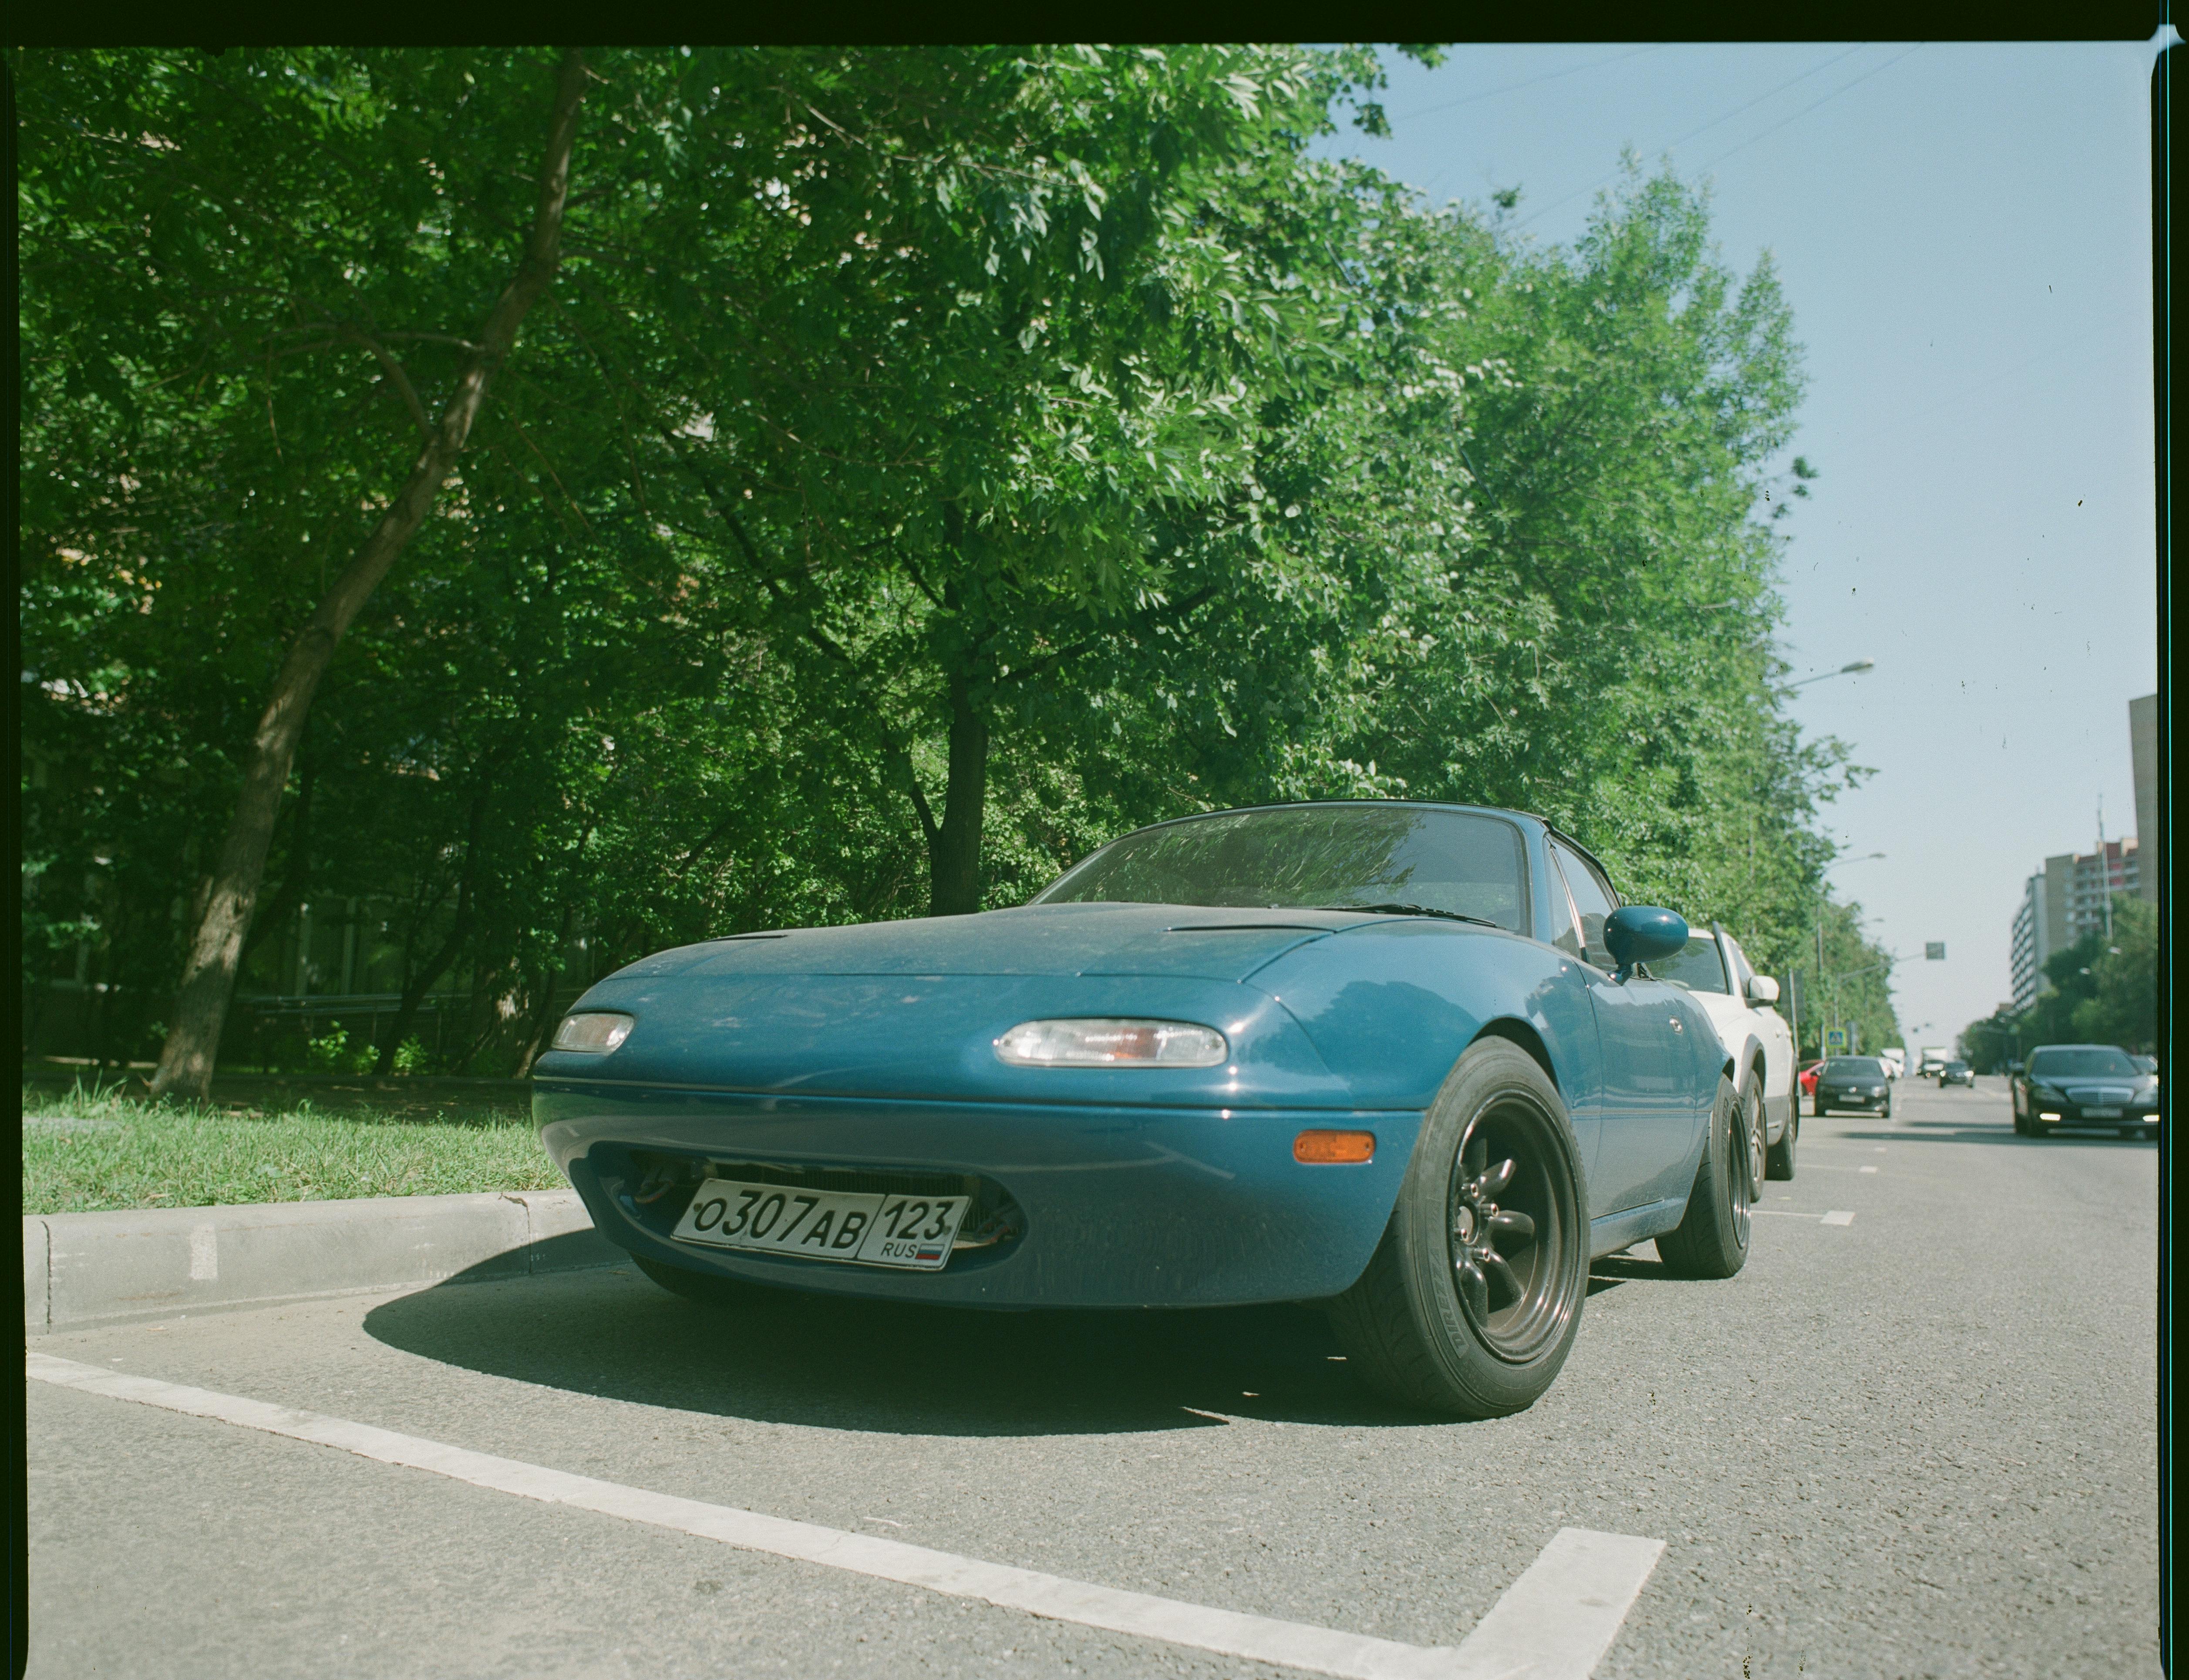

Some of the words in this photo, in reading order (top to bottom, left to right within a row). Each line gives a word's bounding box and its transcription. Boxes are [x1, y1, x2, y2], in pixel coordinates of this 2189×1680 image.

[885, 1200, 955, 1240] 123
[880, 1242, 917, 1258] RUS
[1429, 1248, 1465, 1350] DIREZZA
